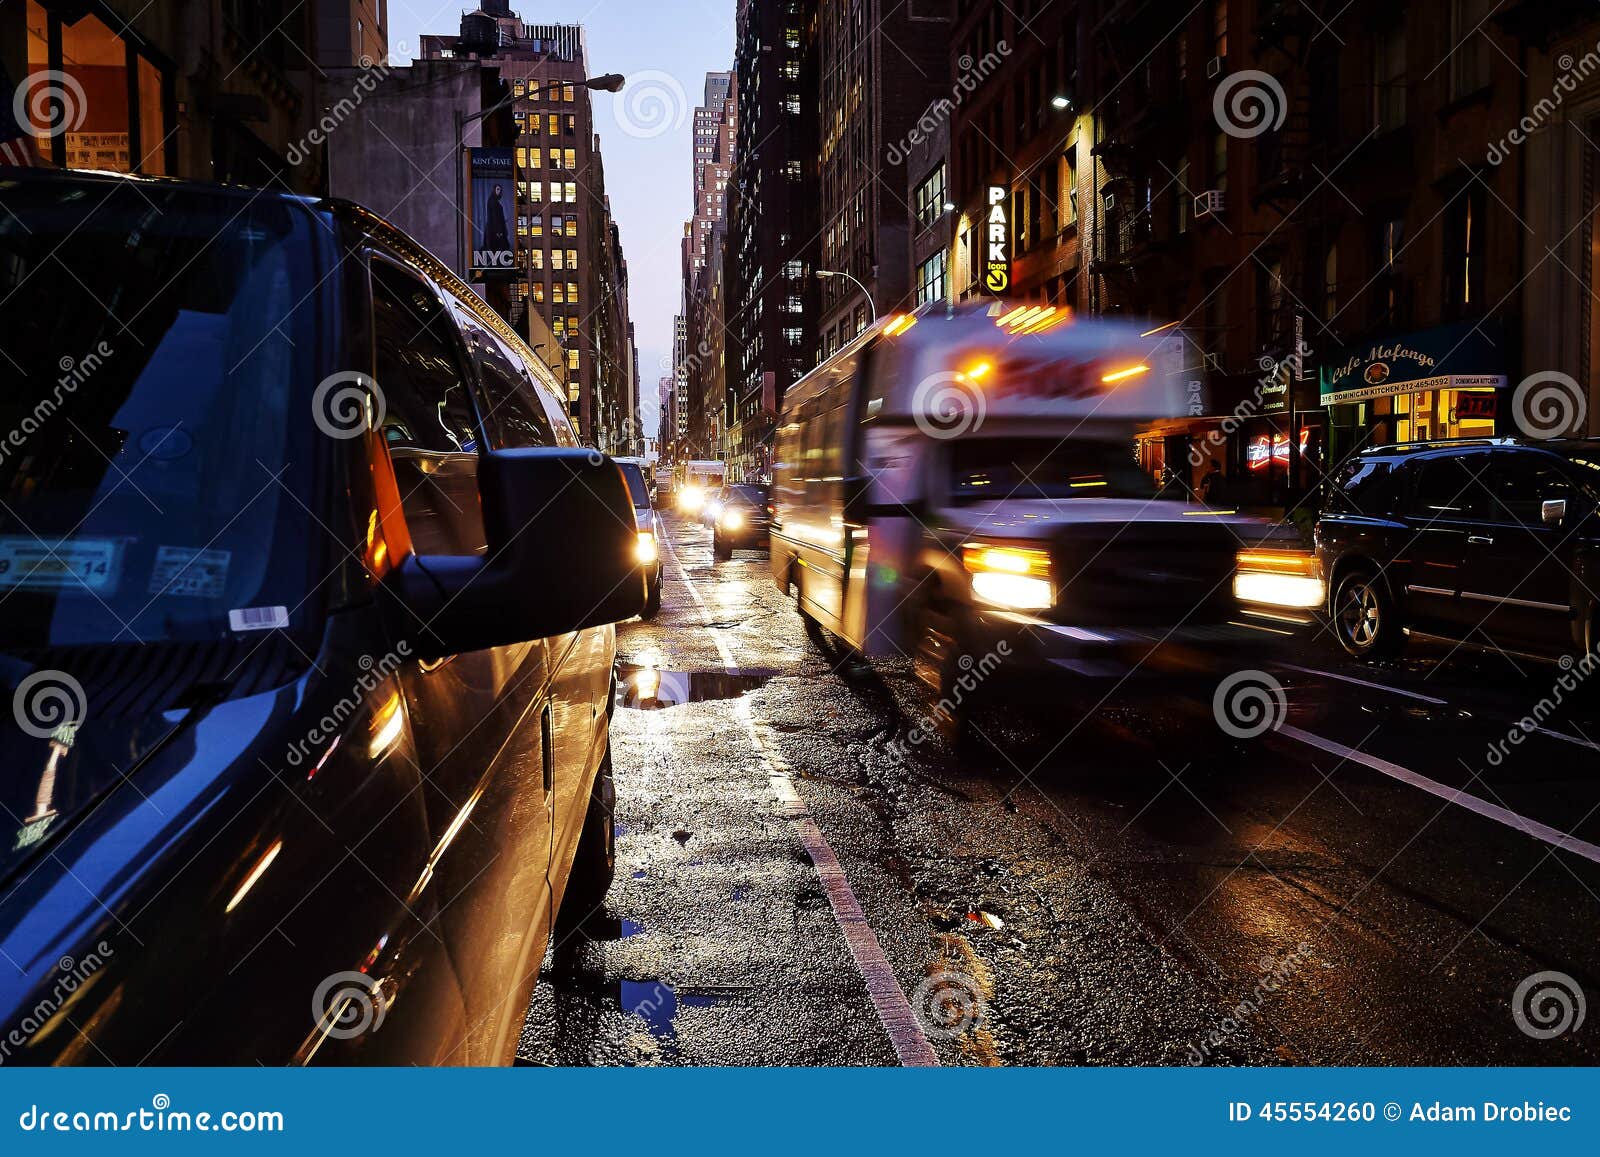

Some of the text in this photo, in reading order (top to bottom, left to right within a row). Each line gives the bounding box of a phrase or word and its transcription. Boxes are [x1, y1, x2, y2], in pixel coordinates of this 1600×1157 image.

[472, 158, 512, 166] KENT STATE
[988, 186, 1007, 261] PARK
[473, 250, 514, 267] NYC
[1332, 343, 1435, 384] Cafe Mofongo
[1187, 380, 1204, 416] BAR
[1334, 389, 1369, 401] DOMINICAN
[1370, 384, 1400, 396] KITCHEN
